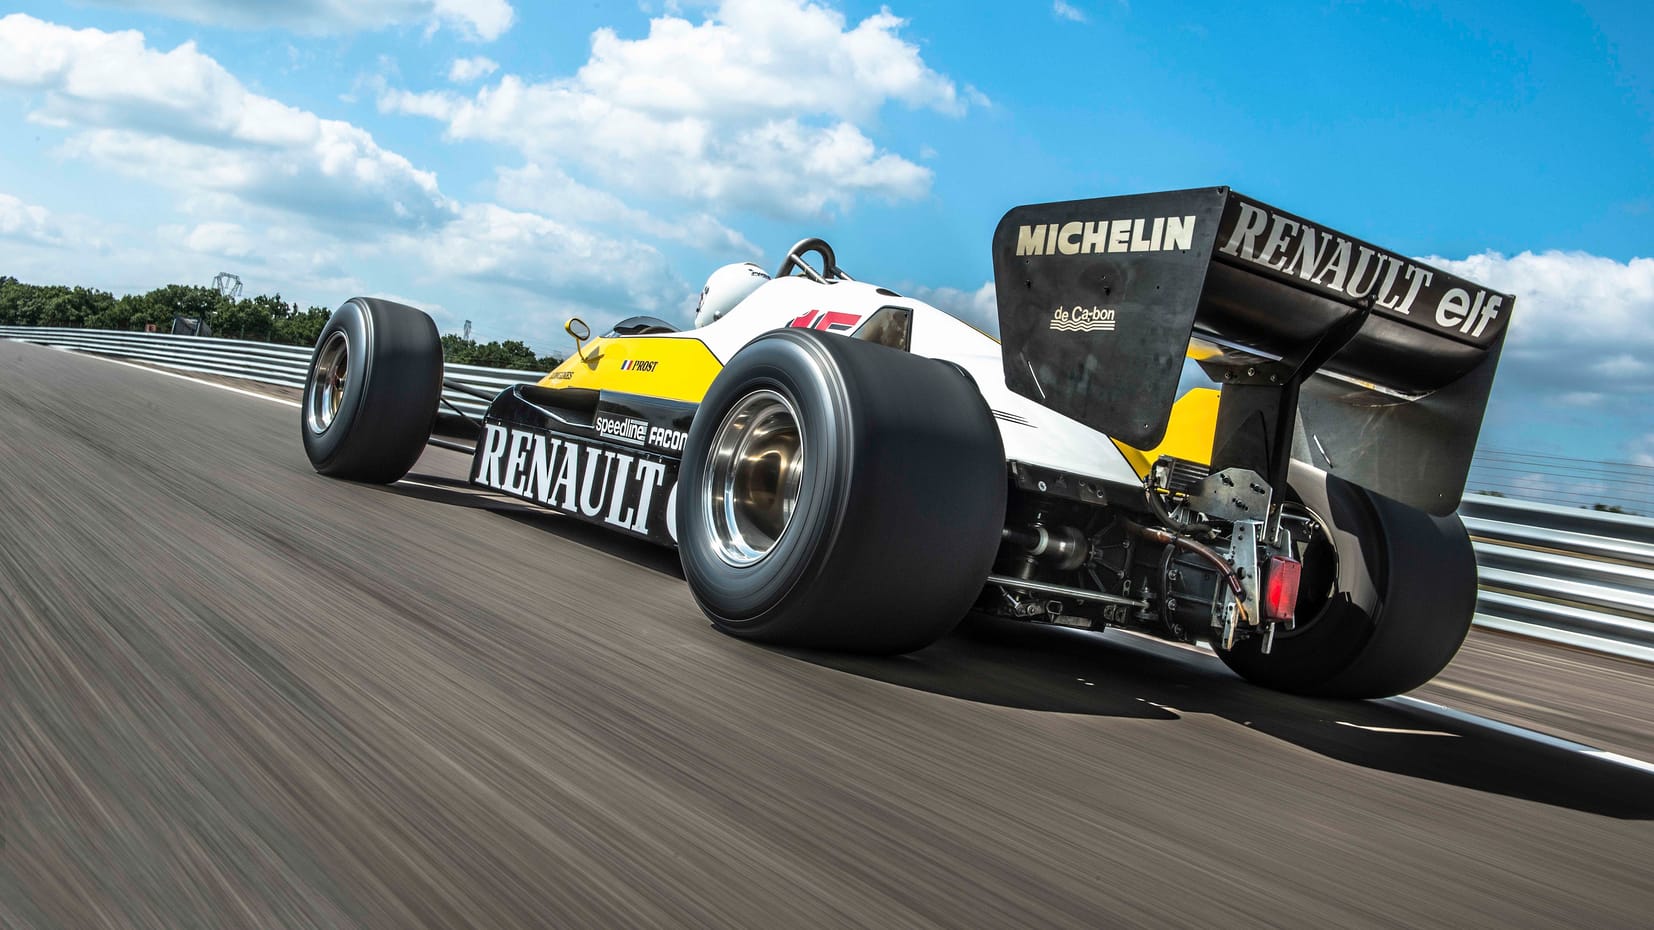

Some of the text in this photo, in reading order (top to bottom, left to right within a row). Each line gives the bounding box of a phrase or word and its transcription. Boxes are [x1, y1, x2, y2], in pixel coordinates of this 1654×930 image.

[1016, 215, 1196, 256] MICHELIN
[1220, 202, 1503, 338] RENAULT elf
[1054, 305, 1068, 321] de
[631, 360, 658, 372] PROST
[595, 416, 646, 442] speedline
[475, 423, 666, 534] RENAULT
